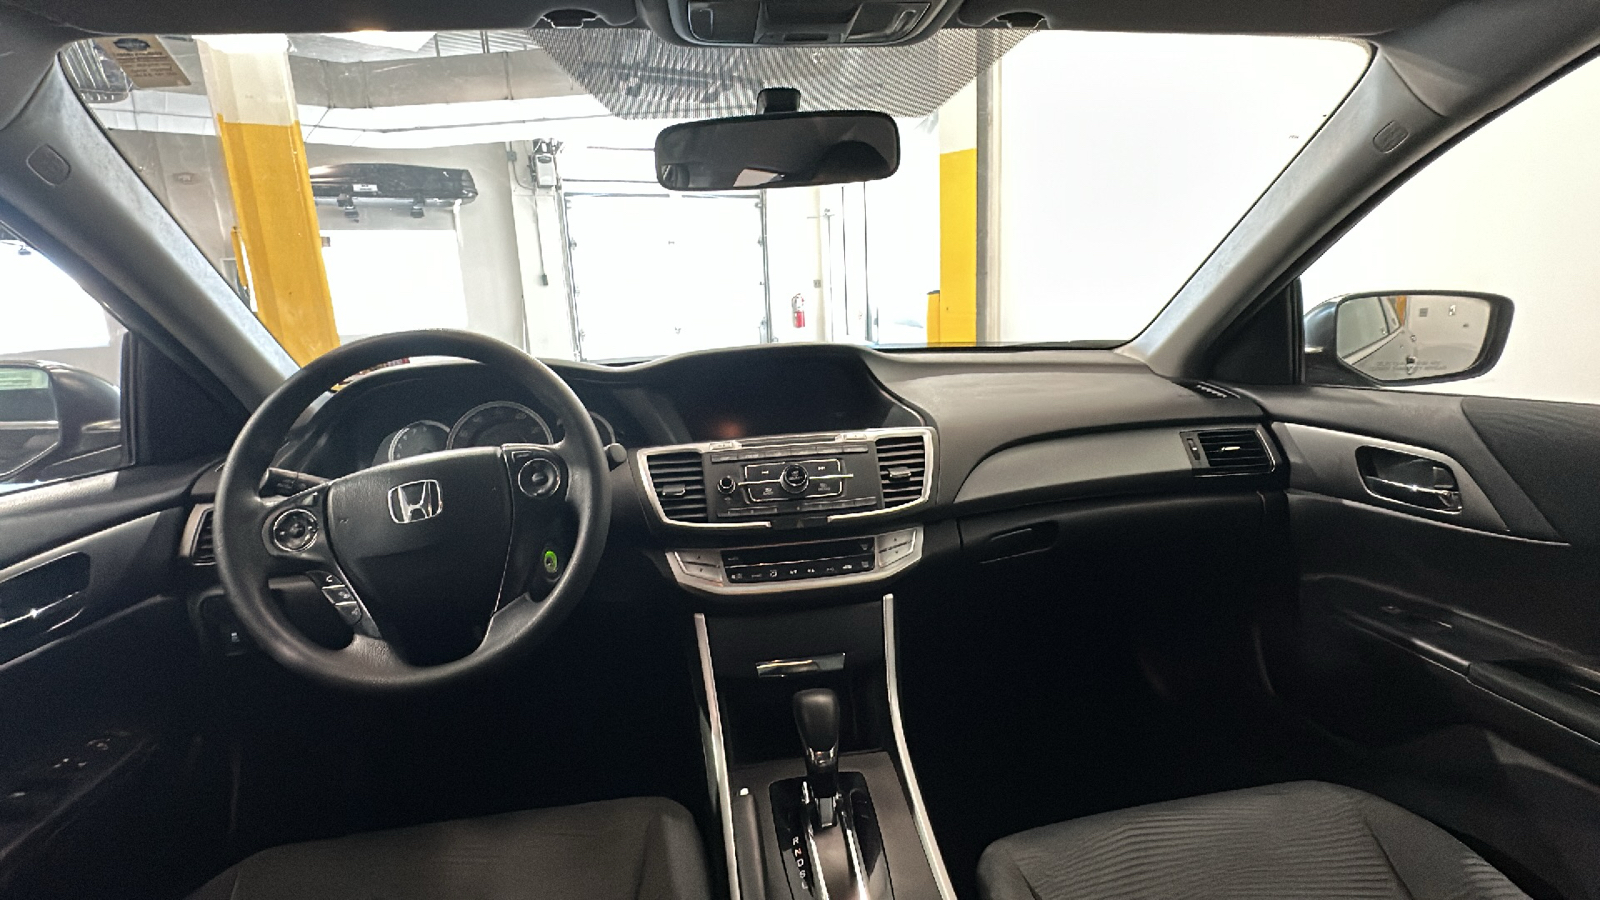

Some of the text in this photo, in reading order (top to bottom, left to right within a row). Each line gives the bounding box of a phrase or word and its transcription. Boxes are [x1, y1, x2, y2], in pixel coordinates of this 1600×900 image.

[792, 836, 799, 846] R
[794, 847, 802, 858] N
[797, 858, 804, 868] D
